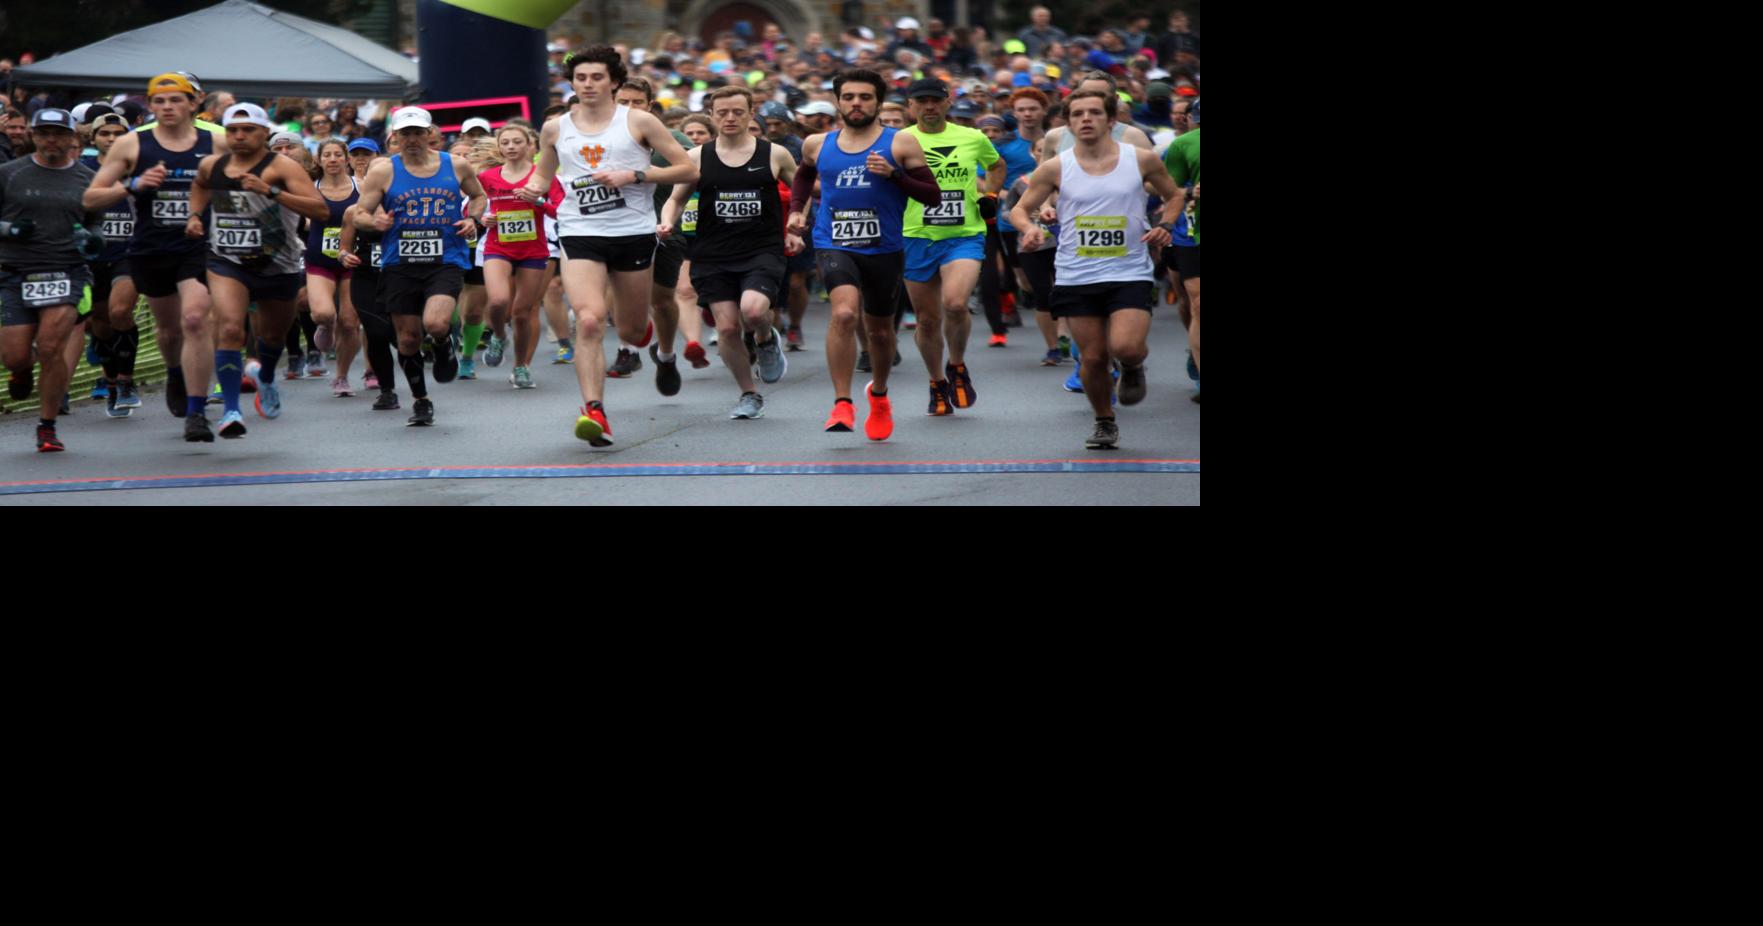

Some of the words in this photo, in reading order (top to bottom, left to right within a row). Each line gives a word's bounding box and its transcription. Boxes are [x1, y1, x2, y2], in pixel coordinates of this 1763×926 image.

[835, 174, 871, 187] ITL
[935, 168, 969, 179] ANTA
[576, 186, 621, 206] 2204
[154, 201, 190, 217] 244
[406, 197, 446, 216] CTC
[716, 202, 760, 216] 2468
[923, 202, 963, 216] 2241
[103, 222, 132, 235] 419
[499, 220, 533, 234] 1321
[833, 221, 878, 238] 2470
[217, 230, 259, 245] 2074
[324, 238, 340, 250] 13
[1078, 230, 1125, 246] 1299
[400, 240, 440, 255] 2261
[24, 281, 68, 298] 2429
